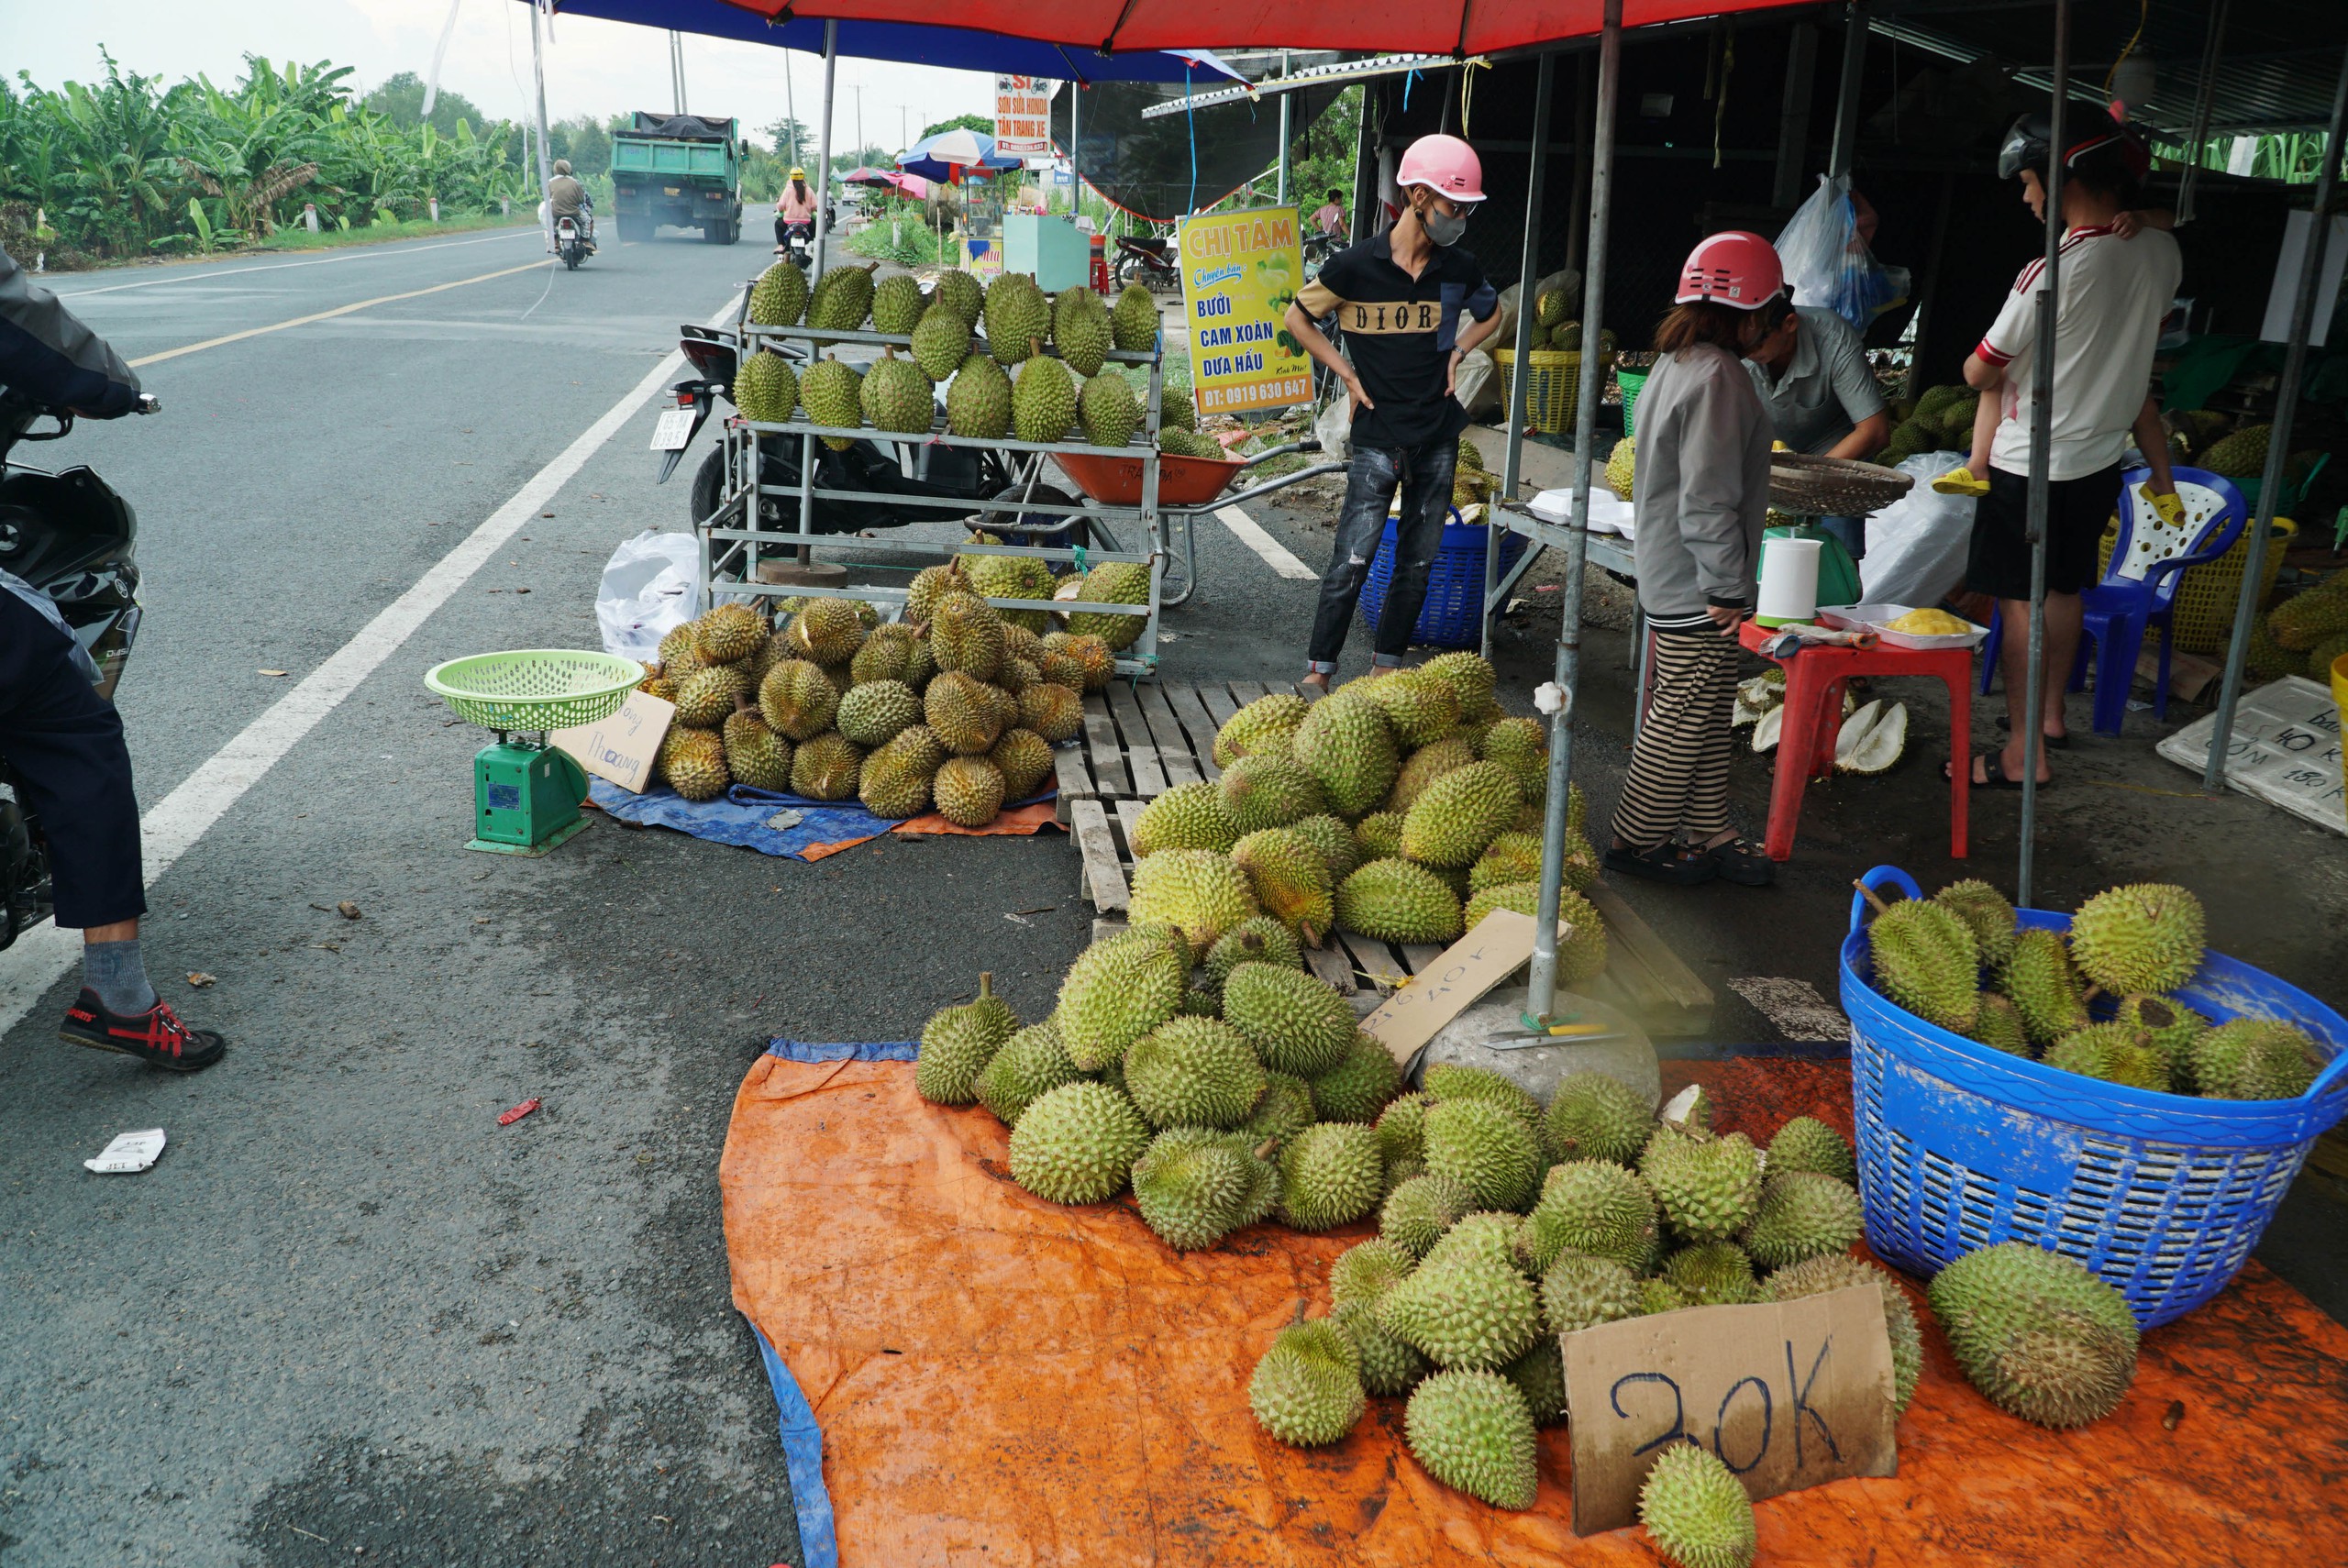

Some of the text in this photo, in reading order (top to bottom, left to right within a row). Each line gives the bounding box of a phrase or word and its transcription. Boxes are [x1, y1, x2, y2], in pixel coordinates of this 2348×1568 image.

[998, 92, 1047, 115] SƠN SỬA HONDA
[998, 116, 1046, 138] TÂN TRANG XE
[1188, 217, 1295, 259] CHỊ TÂM
[1193, 267, 1224, 286] Chuyên
[1197, 292, 1231, 318] BƯỞI
[1356, 305, 1432, 330] DIOR
[1201, 319, 1274, 348] CAM XOÀN
[1202, 347, 1264, 378] DƯA HẤU
[1204, 378, 1307, 407] ĐT: 0919 630 647
